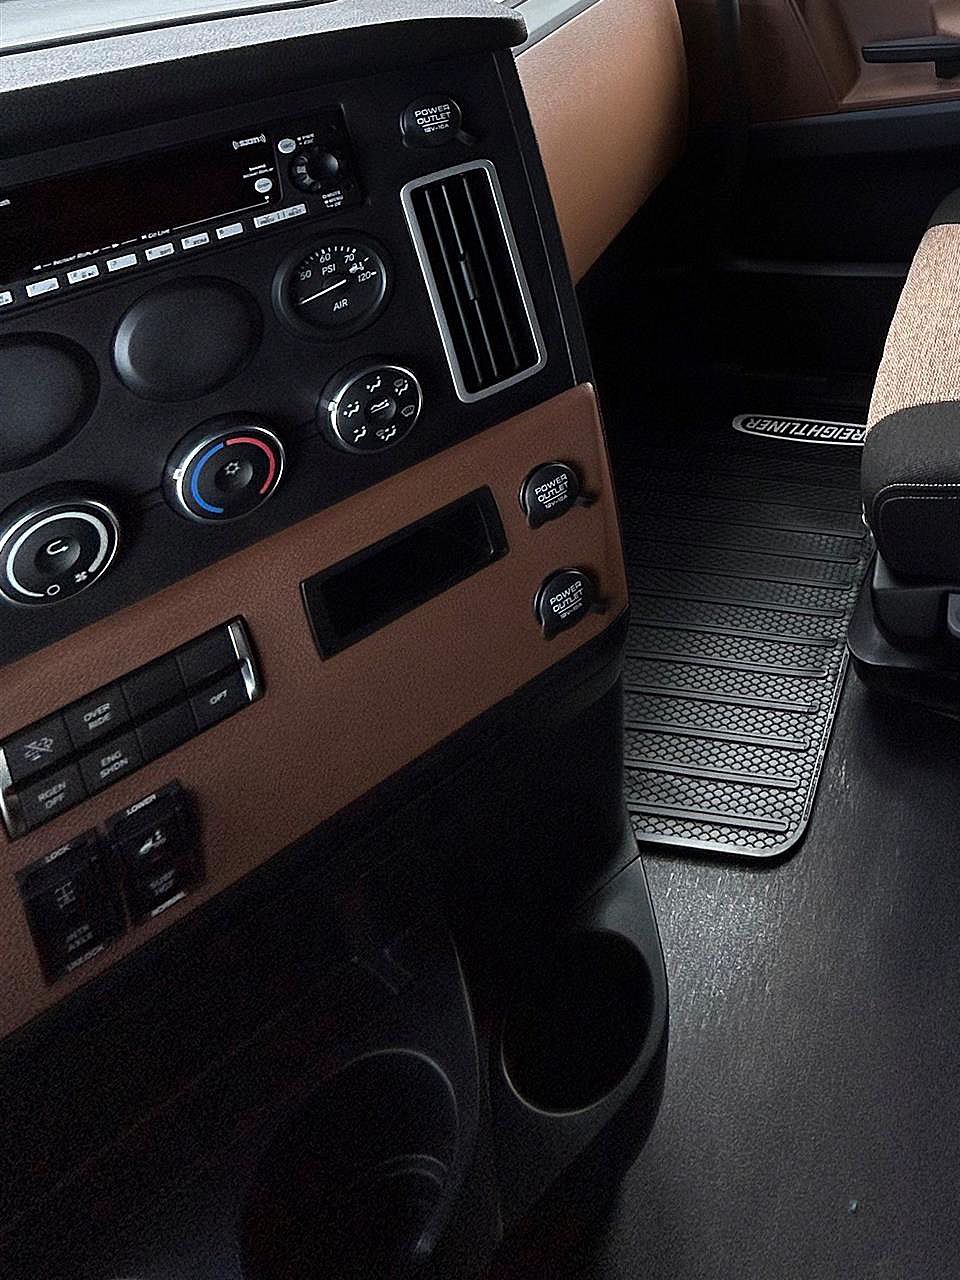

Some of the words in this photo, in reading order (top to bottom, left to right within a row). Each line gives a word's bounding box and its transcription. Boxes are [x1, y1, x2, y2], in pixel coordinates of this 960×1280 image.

[414, 104, 450, 118] POWER
[416, 111, 451, 125] OUTLET
[319, 252, 331, 264] 60
[343, 252, 355, 264] 70
[300, 269, 312, 281] 50
[321, 263, 336, 276] PSI
[357, 270, 371, 283] 120
[332, 298, 348, 312] AIR
[745, 418, 867, 442] REIGHTLINER
[534, 473, 568, 496] POWER
[537, 480, 569, 503] OUTLET
[549, 580, 582, 606] POWER
[552, 588, 584, 613] OUTLET
[83, 703, 111, 723] OVER
[88, 713, 112, 731] RIDE
[100, 750, 122, 767] ENG
[37, 781, 66, 803] RGEN
[44, 793, 65, 810] OFF
[125, 793, 157, 817] LOWER
